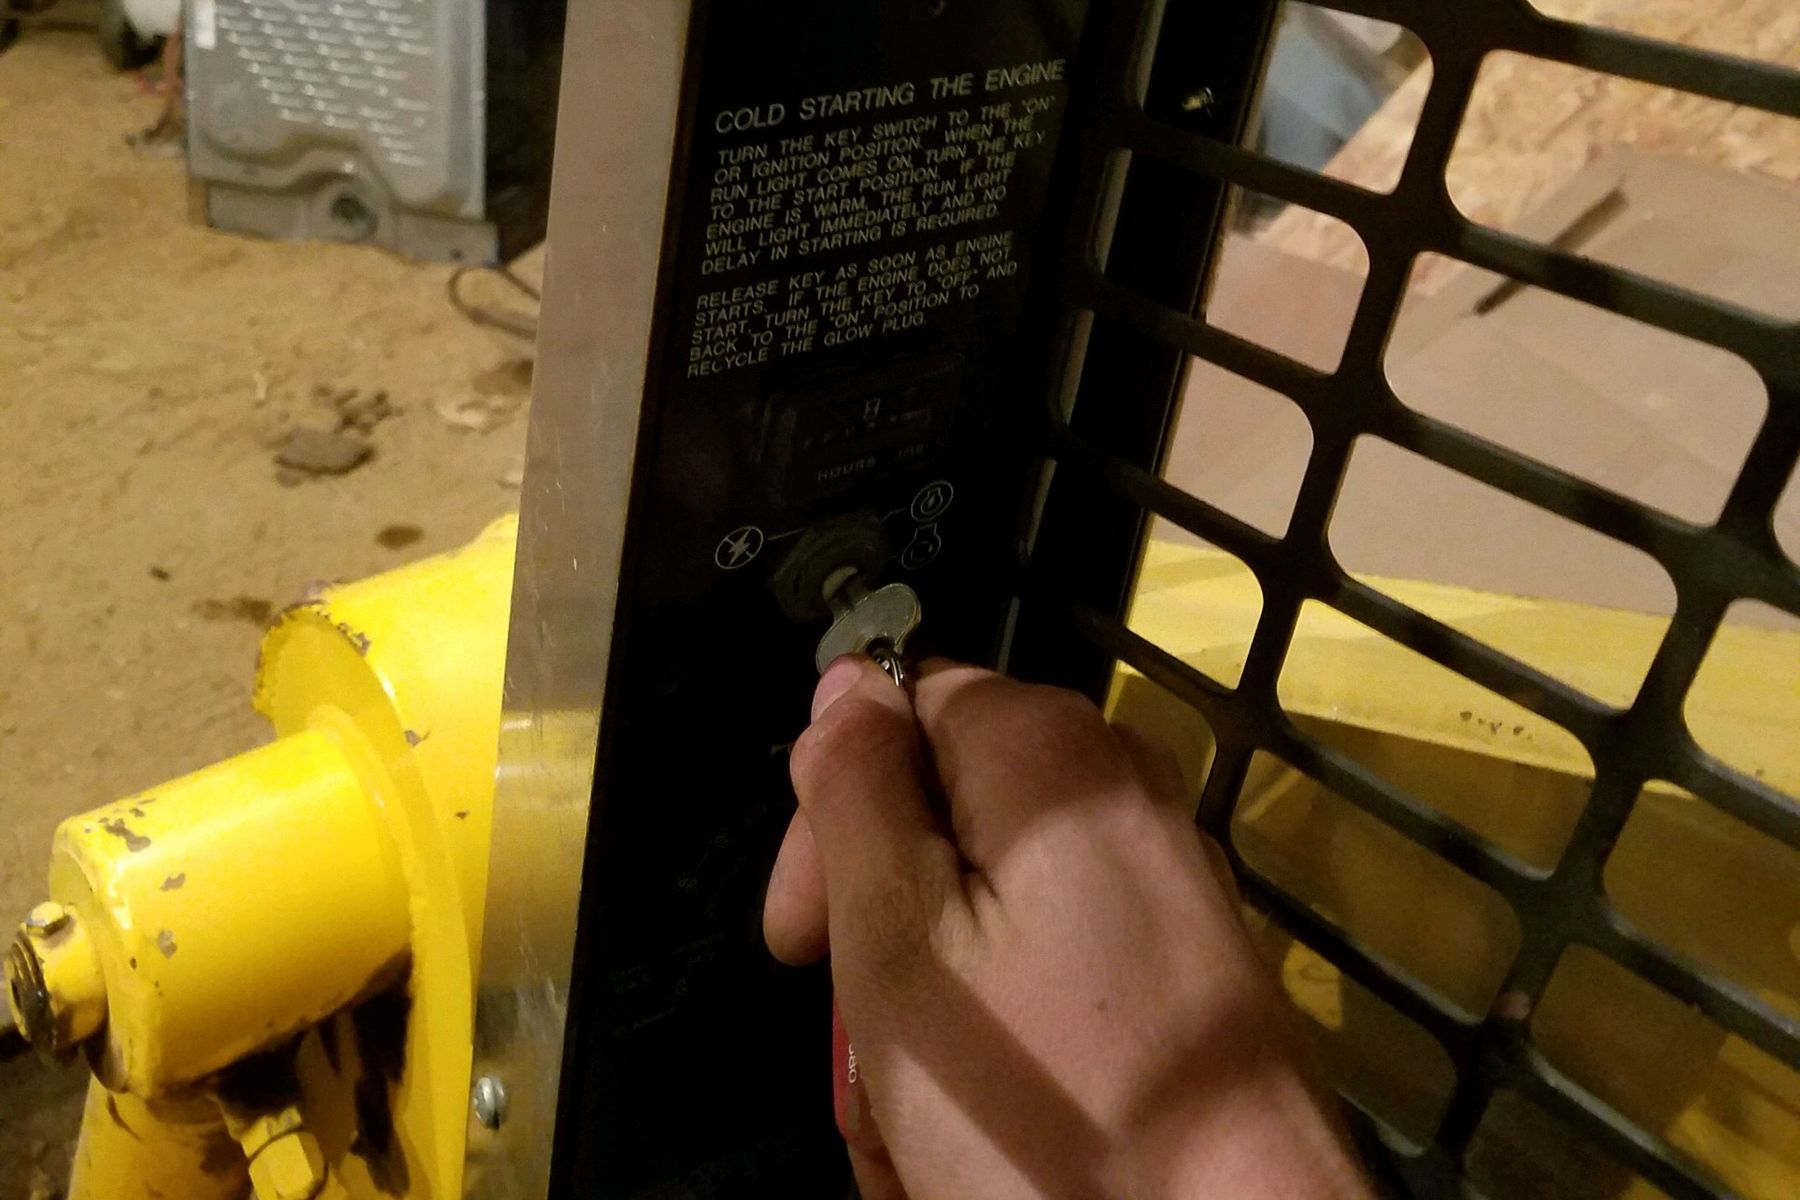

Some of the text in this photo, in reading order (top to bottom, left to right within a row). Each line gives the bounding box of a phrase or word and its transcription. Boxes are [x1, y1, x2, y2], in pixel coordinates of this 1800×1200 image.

[714, 58, 1067, 135] COLD STARTING THE ENGINE
[710, 183, 748, 203] RUN
[757, 172, 807, 195] LIGHT
[817, 160, 878, 184] COMES
[925, 144, 967, 165] TURN
[976, 136, 1008, 155] THE
[1013, 130, 1046, 149] KEY
[714, 166, 741, 185] OR
[752, 152, 830, 178] IGNITION
[945, 123, 993, 143] WHEN
[1003, 115, 1034, 135] THE
[718, 144, 767, 165] TURN
[780, 134, 815, 155] THE
[825, 127, 861, 148] KEY
[872, 115, 938, 140] SWITCH
[948, 109, 969, 127] TO
[981, 102, 1012, 121] THE
[705, 185, 1007, 257] WILL LIGHT IMMEDIATELY AND NO
[706, 212, 775, 240] ENGINE
[785, 207, 802, 225] IS
[881, 186, 914, 206] THE
[922, 178, 956, 198] RUN
[965, 167, 1012, 191] LIGHT
[711, 203, 735, 221] TO
[748, 193, 783, 213] THE
[793, 181, 850, 206] START
[960, 157, 976, 176] IF
[986, 151, 1016, 170] THE
[696, 230, 1015, 311] RELEASE KEY AS SOON AS ENGINE
[701, 249, 761, 276] DELAY
[770, 245, 788, 262] IN
[799, 224, 882, 256] STARTING
[891, 220, 907, 238] IS
[788, 290, 805, 308] IF
[815, 280, 849, 301] THE
[858, 265, 919, 293] ENGINE
[928, 255, 972, 278] DOES
[980, 247, 1011, 266] NOT
[689, 337, 738, 363] BACK
[751, 329, 774, 348] TO
[785, 319, 819, 340] THE
[873, 290, 950, 320] POSITION
[960, 283, 979, 301] TO
[763, 305, 810, 328] TURN
[820, 296, 854, 316] THE
[861, 287, 896, 308] KEY
[906, 280, 927, 298] TO
[986, 260, 1018, 281] AND
[687, 346, 769, 379] RECYCLE
[780, 336, 814, 357] THE
[823, 323, 874, 348] GLOW
